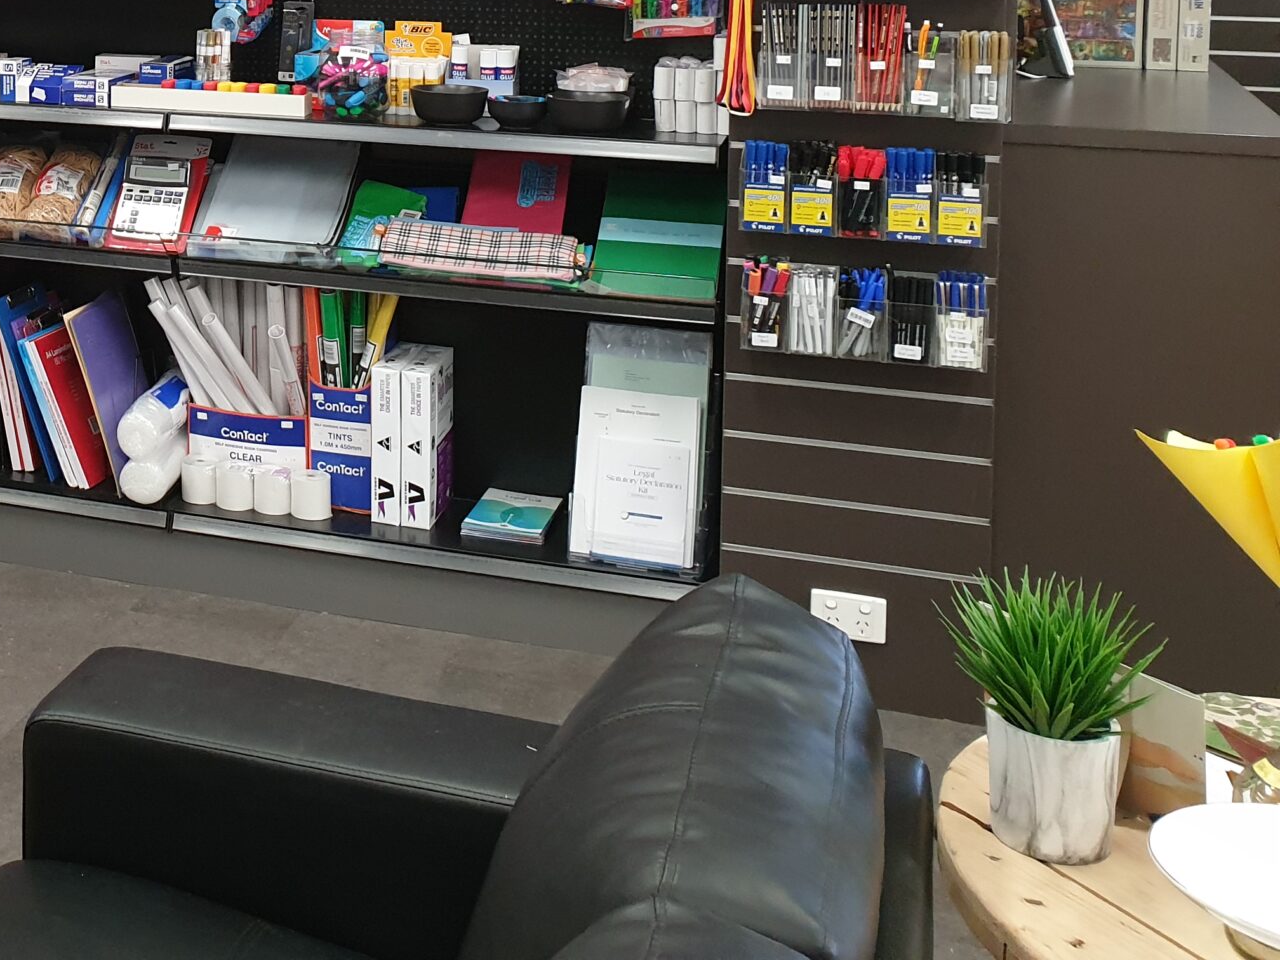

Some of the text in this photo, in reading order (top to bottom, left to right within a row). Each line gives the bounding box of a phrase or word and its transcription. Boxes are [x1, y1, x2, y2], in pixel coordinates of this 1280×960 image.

[134, 141, 155, 151] Stat
[327, 432, 353, 442] TINTS
[229, 451, 262, 464] CLEAR
